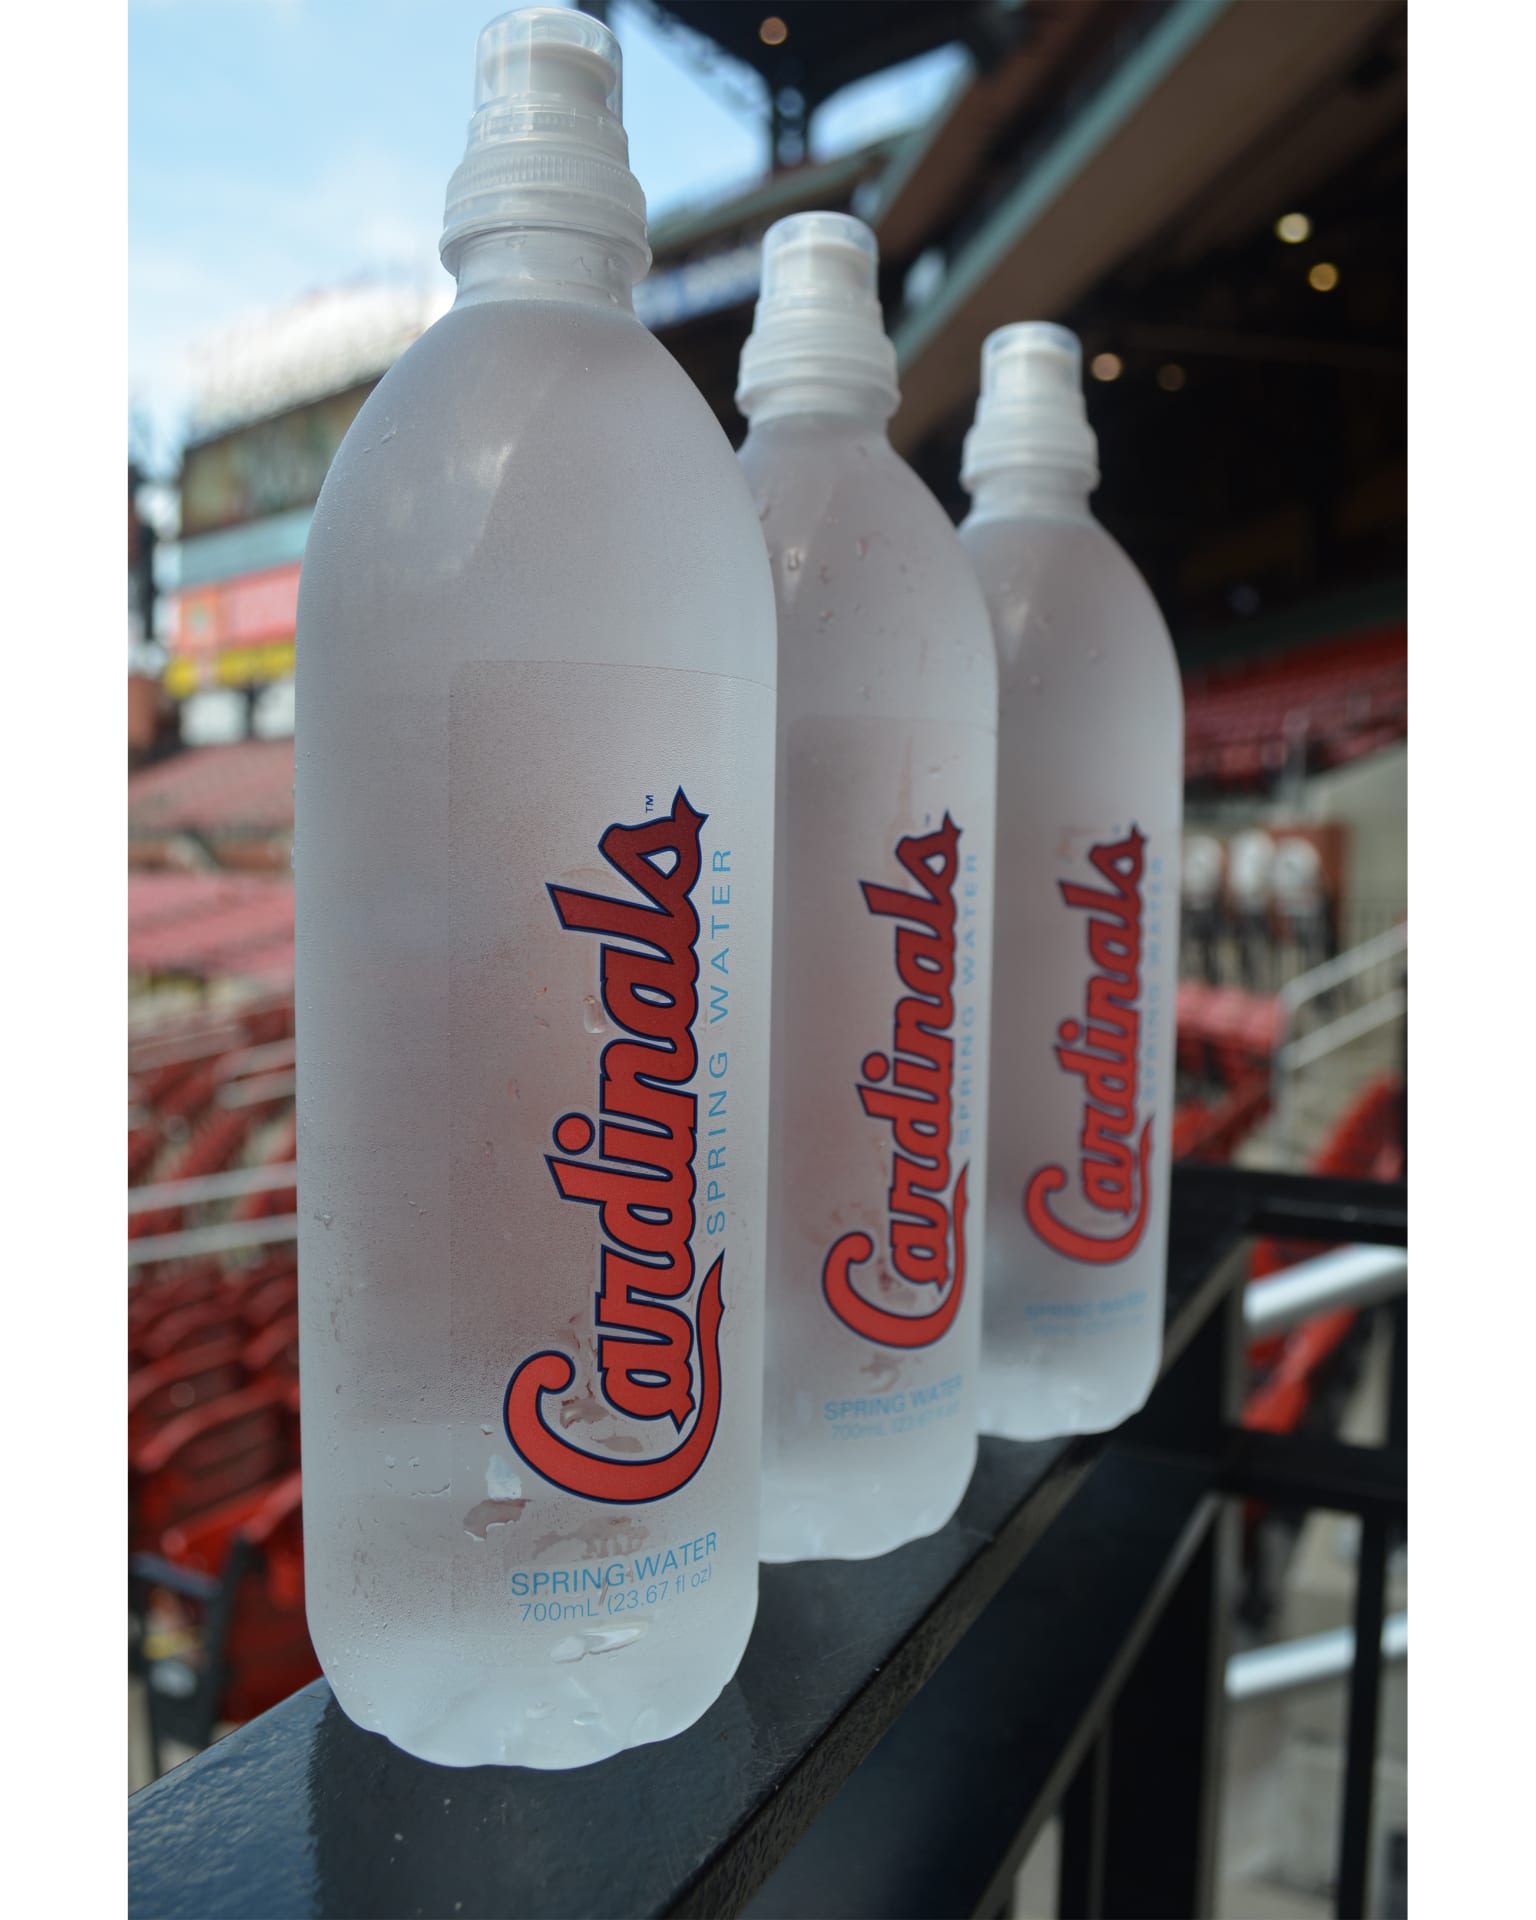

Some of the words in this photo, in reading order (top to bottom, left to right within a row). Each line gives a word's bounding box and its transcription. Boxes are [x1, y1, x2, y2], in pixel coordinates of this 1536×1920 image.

[709, 849, 732, 1024] WATER
[821, 808, 970, 1349] Cardinals
[1024, 823, 1155, 1265] Cardinals
[503, 785, 726, 1504] Cardinals
[706, 1052, 729, 1236] SPRING
[824, 1391, 906, 1421] SPRING
[511, 1563, 625, 1596] SPRING
[634, 1531, 717, 1581] WATER
[519, 1598, 600, 1622] 700mL
[607, 1580, 669, 1615] (23.67
[674, 1579, 686, 1595] fl
[690, 1562, 712, 1588] oz)
